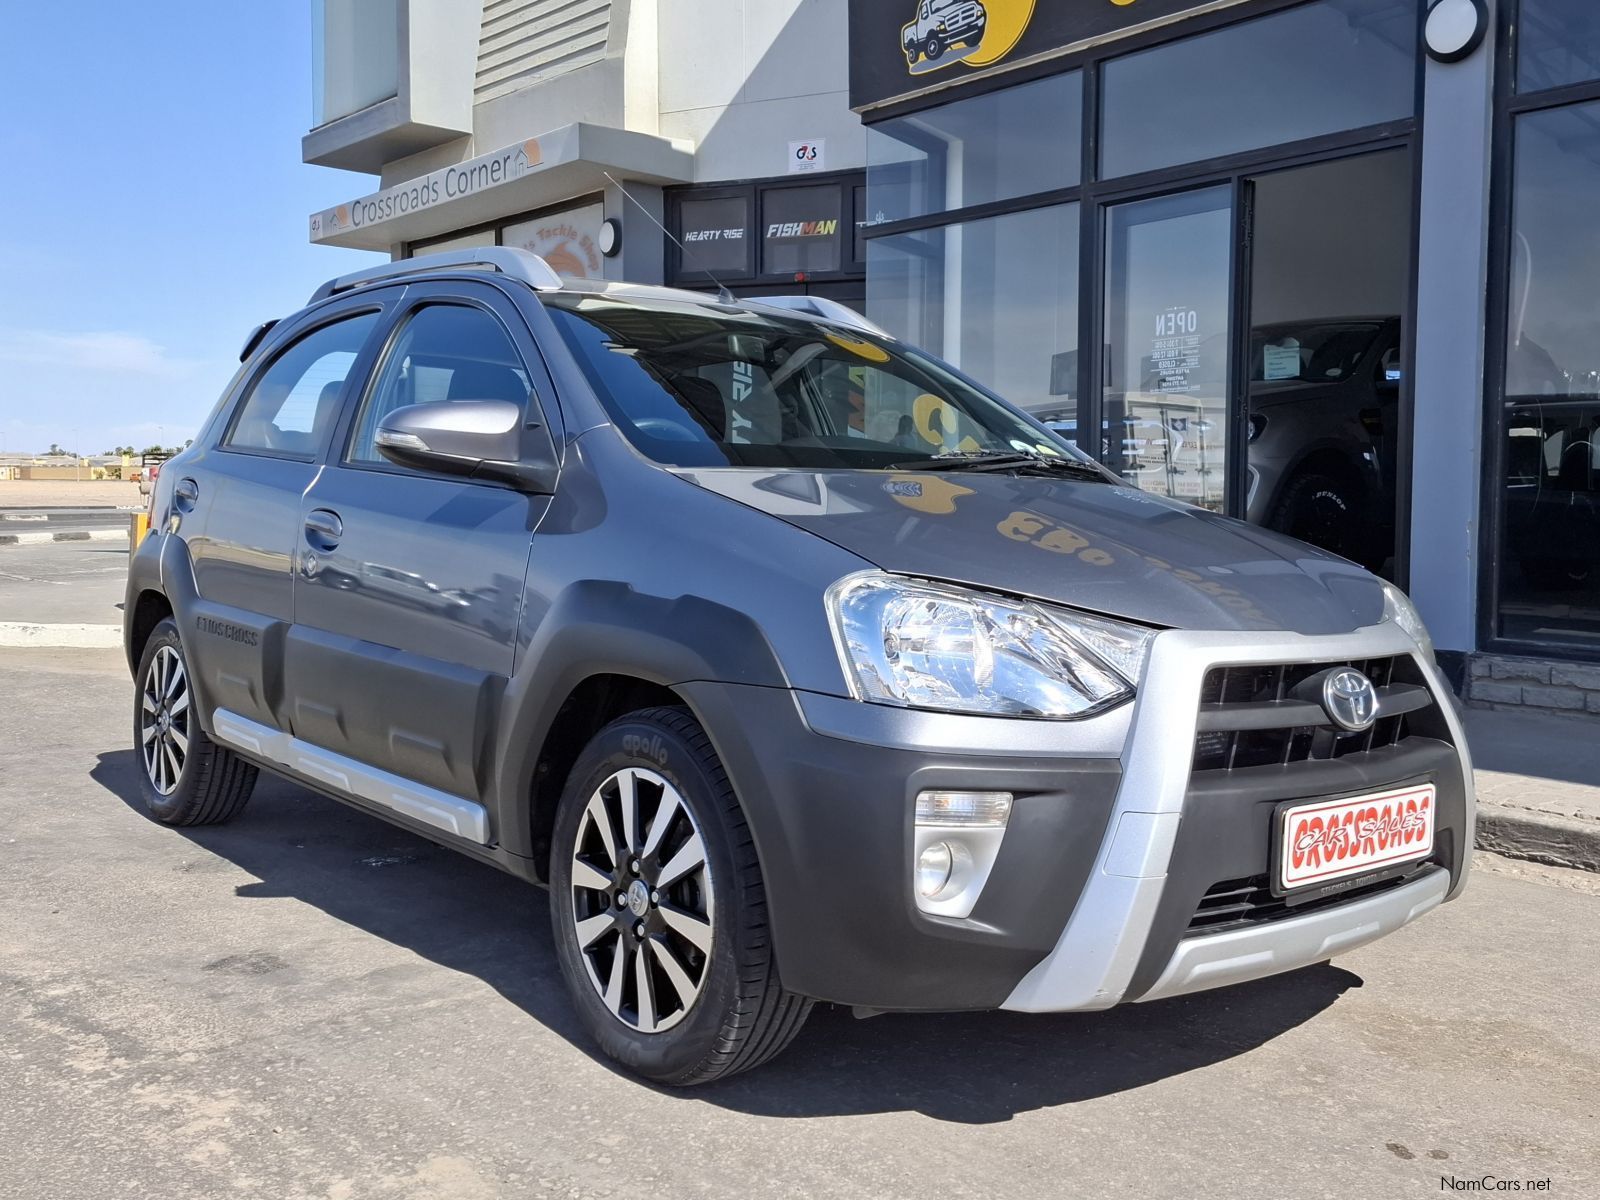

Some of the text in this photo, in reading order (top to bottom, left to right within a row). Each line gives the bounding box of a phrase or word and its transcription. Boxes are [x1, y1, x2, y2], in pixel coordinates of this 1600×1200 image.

[351, 154, 511, 227] Crossroads Corner
[685, 228, 744, 242] HEARTY RISE
[766, 219, 838, 239] FISHMAN
[225, 624, 258, 647] CROSS
[622, 734, 668, 765] apollo
[1291, 795, 1430, 870] CROSSROADS
[1296, 811, 1426, 851] CAR SALES
